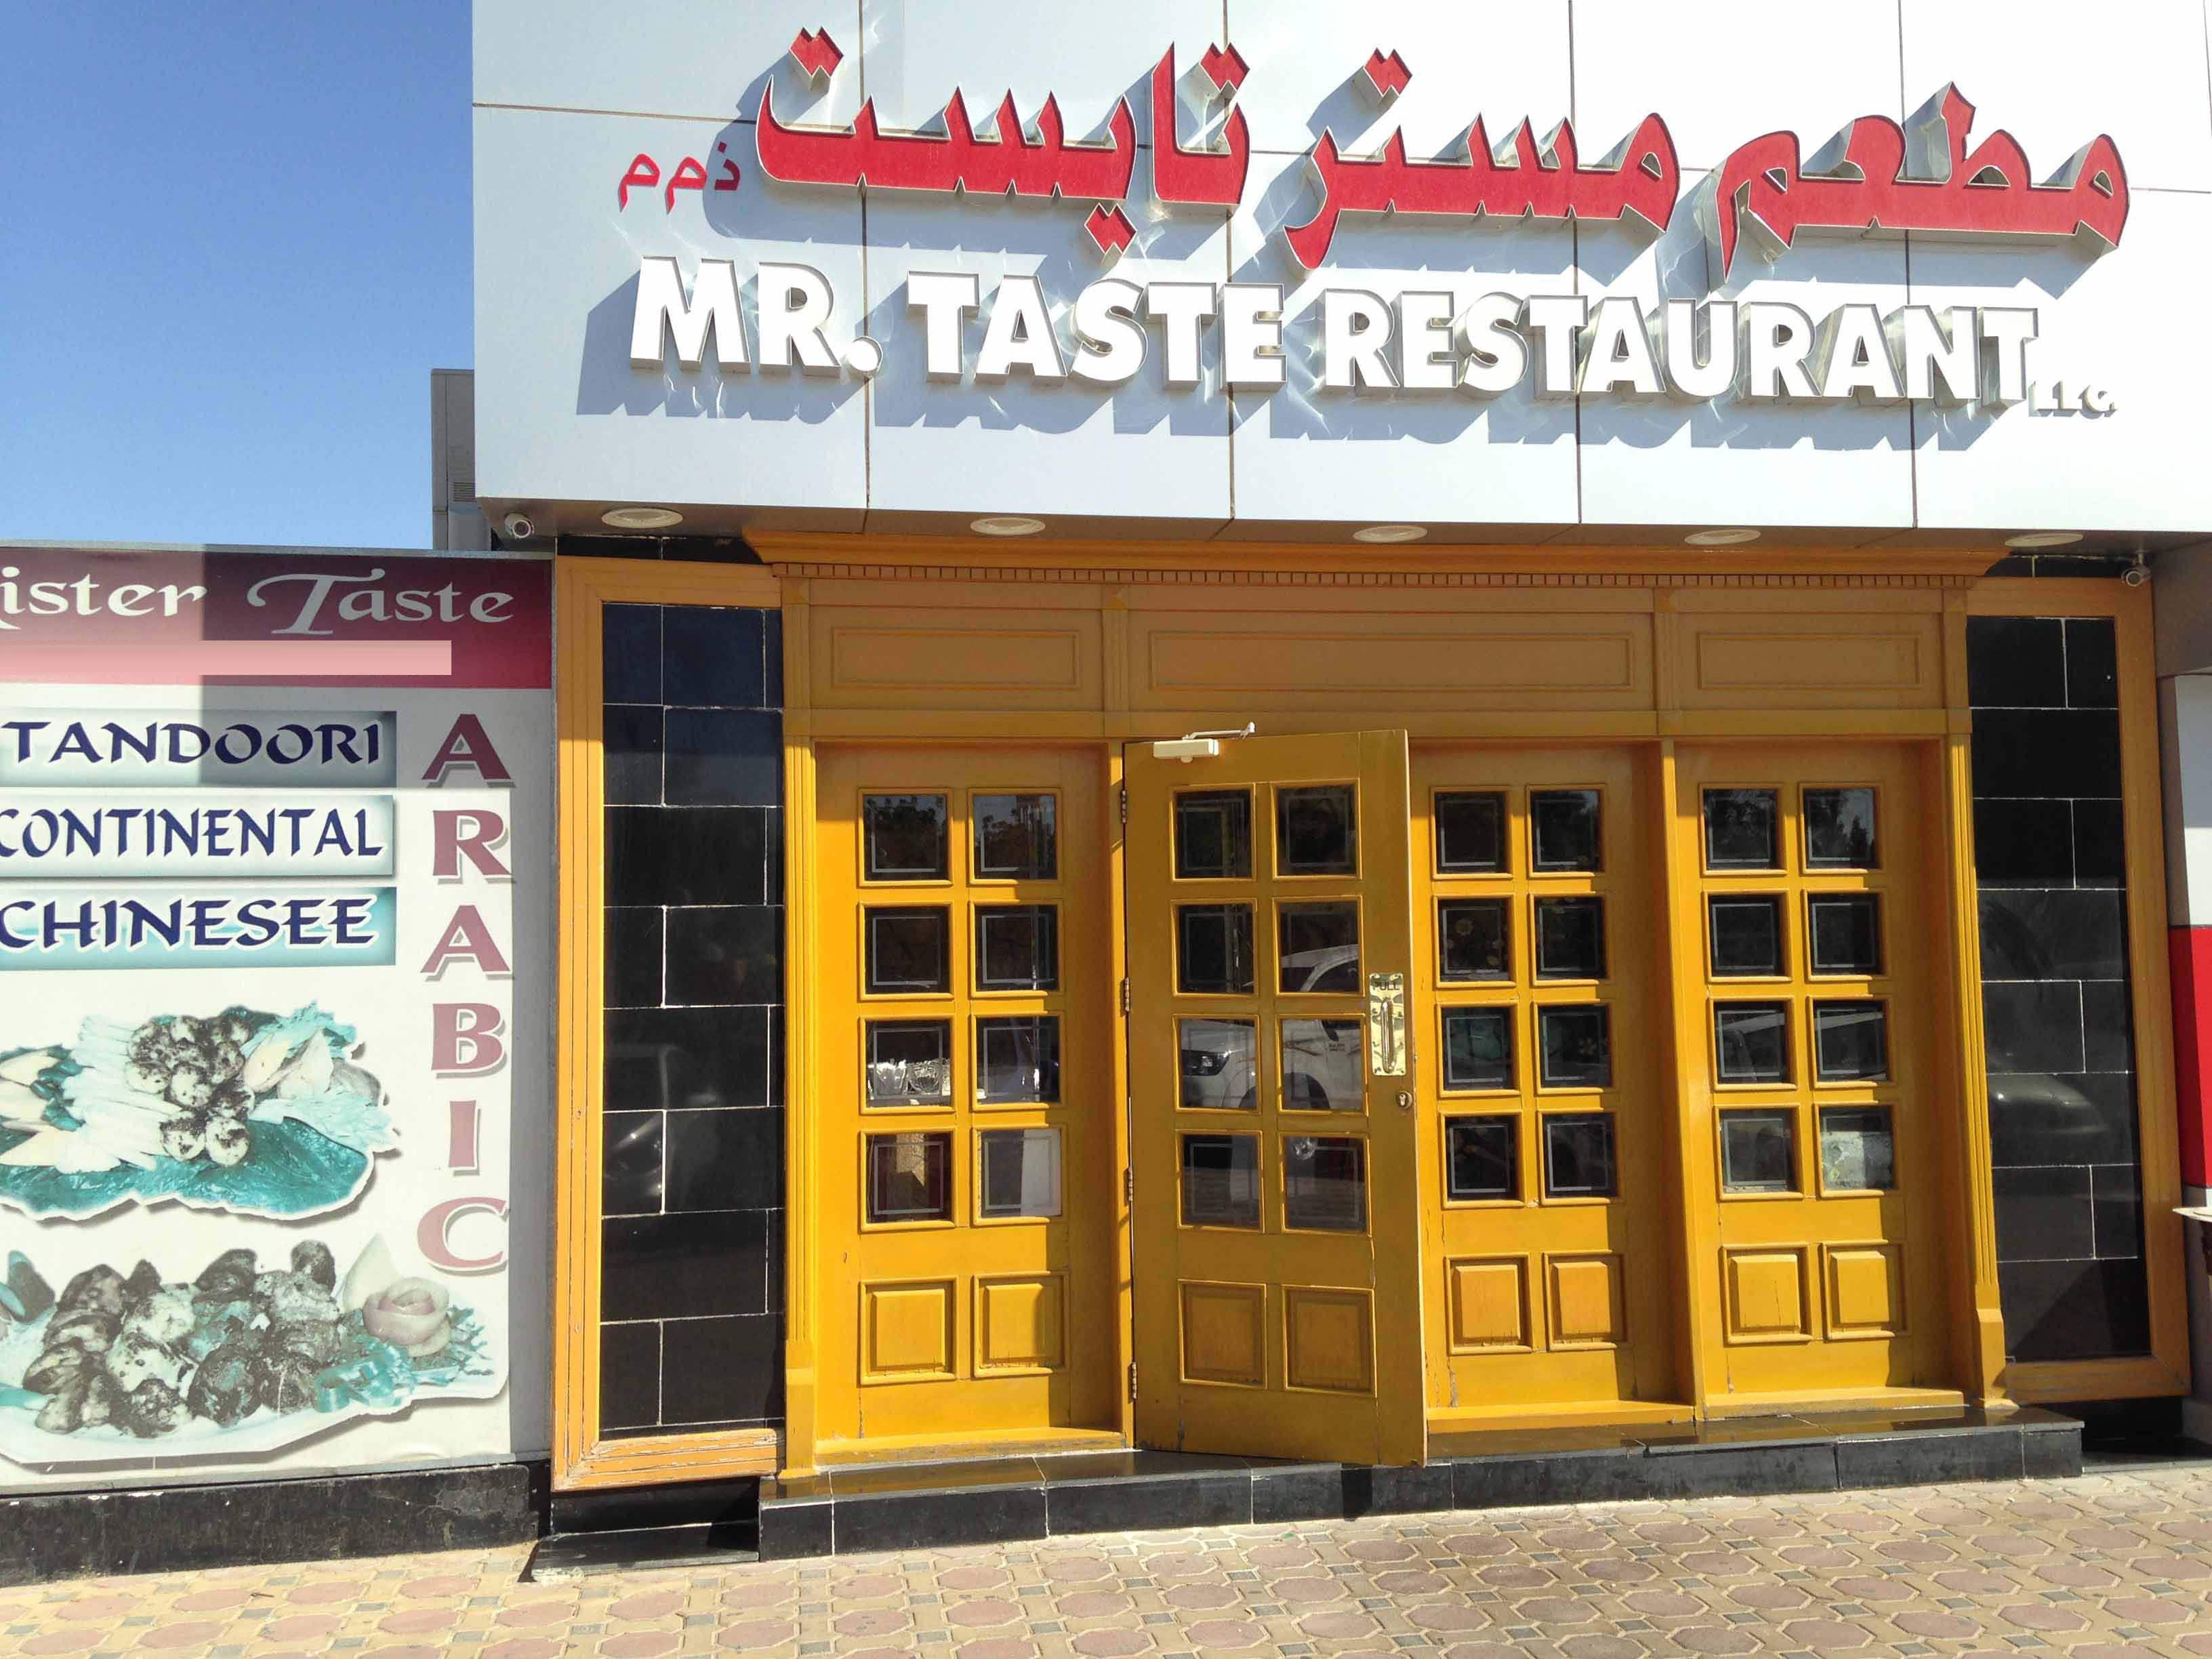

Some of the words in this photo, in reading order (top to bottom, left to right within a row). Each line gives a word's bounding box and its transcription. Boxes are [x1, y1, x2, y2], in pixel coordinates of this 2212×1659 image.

[756, 26, 1250, 253] تايست
[1283, 49, 1681, 269] مستر
[1717, 81, 2129, 280] مطعم
[631, 258, 883, 376] MR.
[907, 270, 1286, 384] TASTE
[1322, 288, 2038, 401] RESTAURANT
[0, 566, 207, 630] ister
[246, 568, 515, 635] Taste
[1, 721, 381, 764] TANDOORI
[0, 899, 376, 949] CHINESEE
[416, 713, 512, 1270] ARABIC
[1374, 982, 1400, 991] PULL
